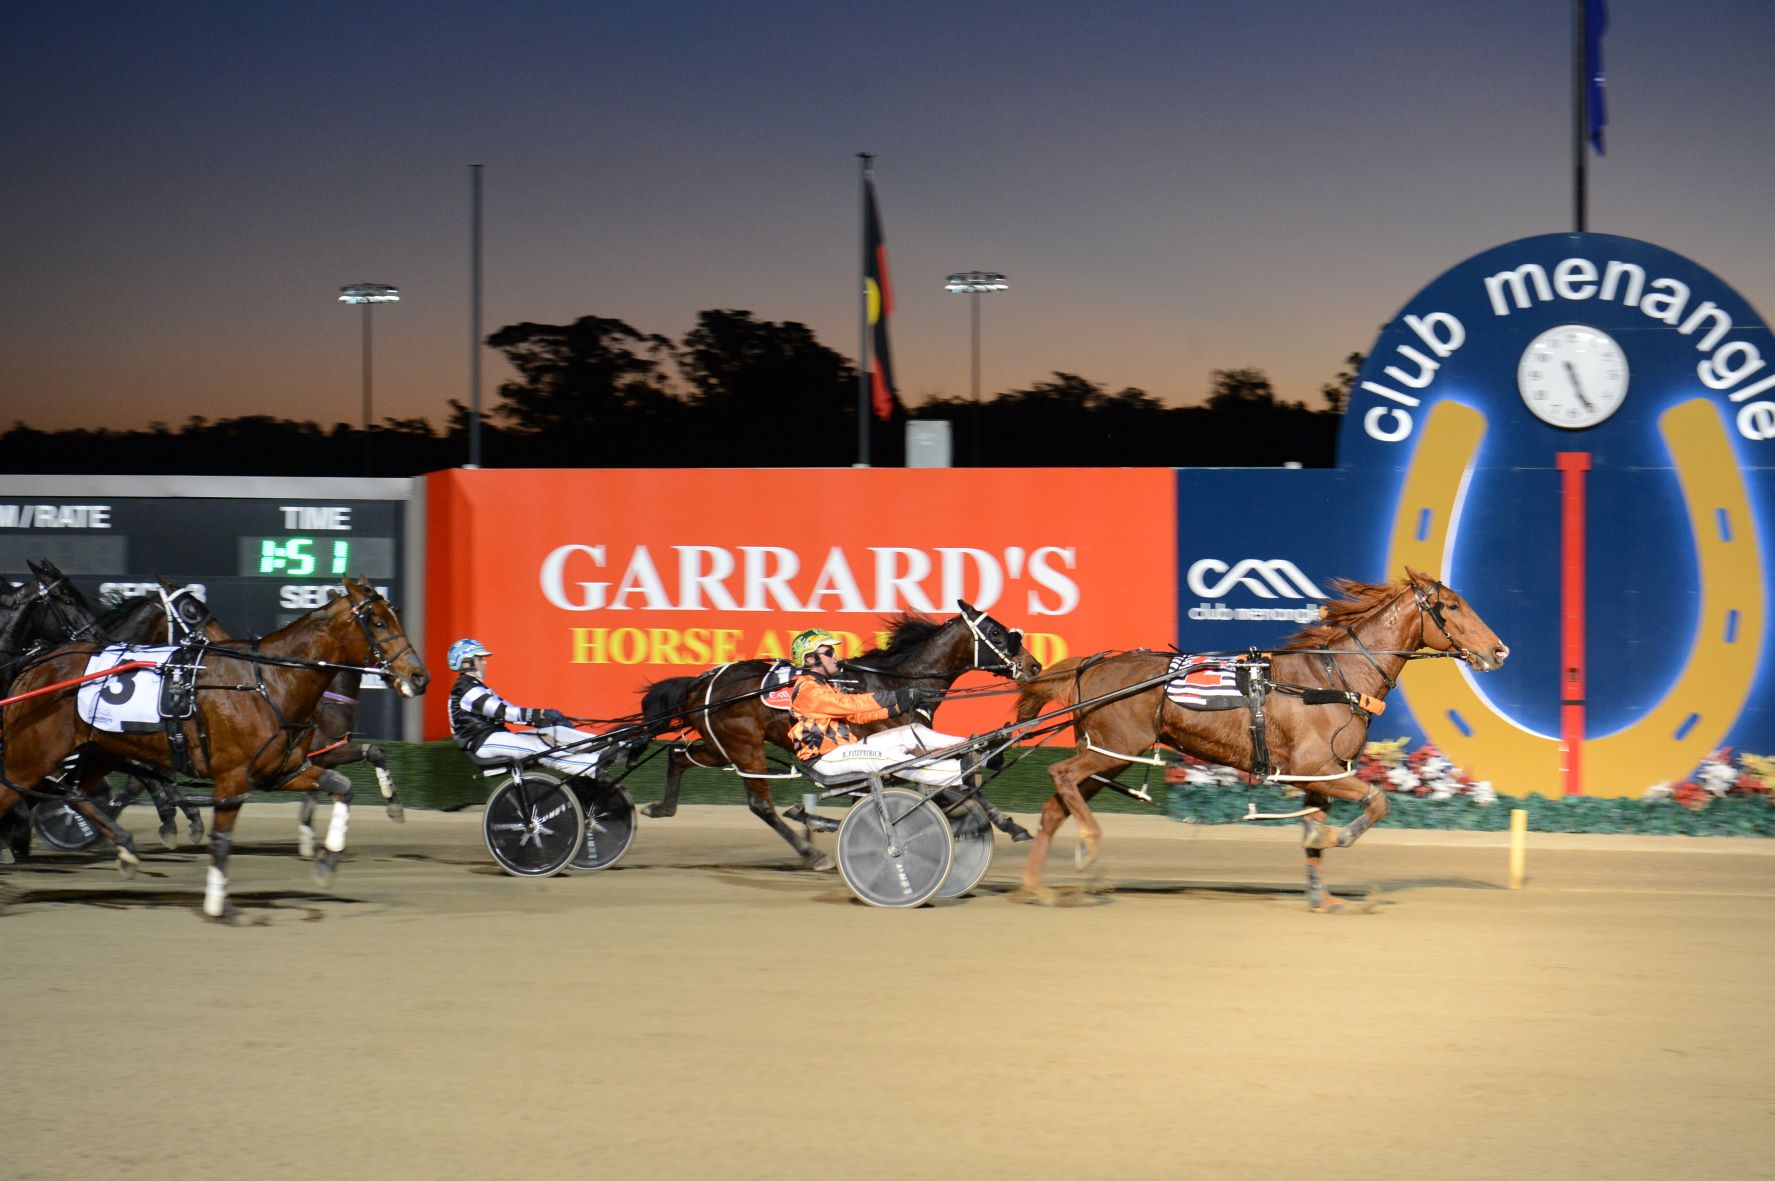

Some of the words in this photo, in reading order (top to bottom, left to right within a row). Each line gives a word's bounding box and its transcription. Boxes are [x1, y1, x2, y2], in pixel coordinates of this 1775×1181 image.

[1361, 311, 1467, 443] club
[1484, 257, 1775, 440] menangle
[279, 506, 352, 530] TIME
[539, 544, 1081, 616] GARRARD'S
[1234, 603, 1322, 624] menangl
[571, 627, 744, 666] HORSE
[751, 629, 864, 661] AD
